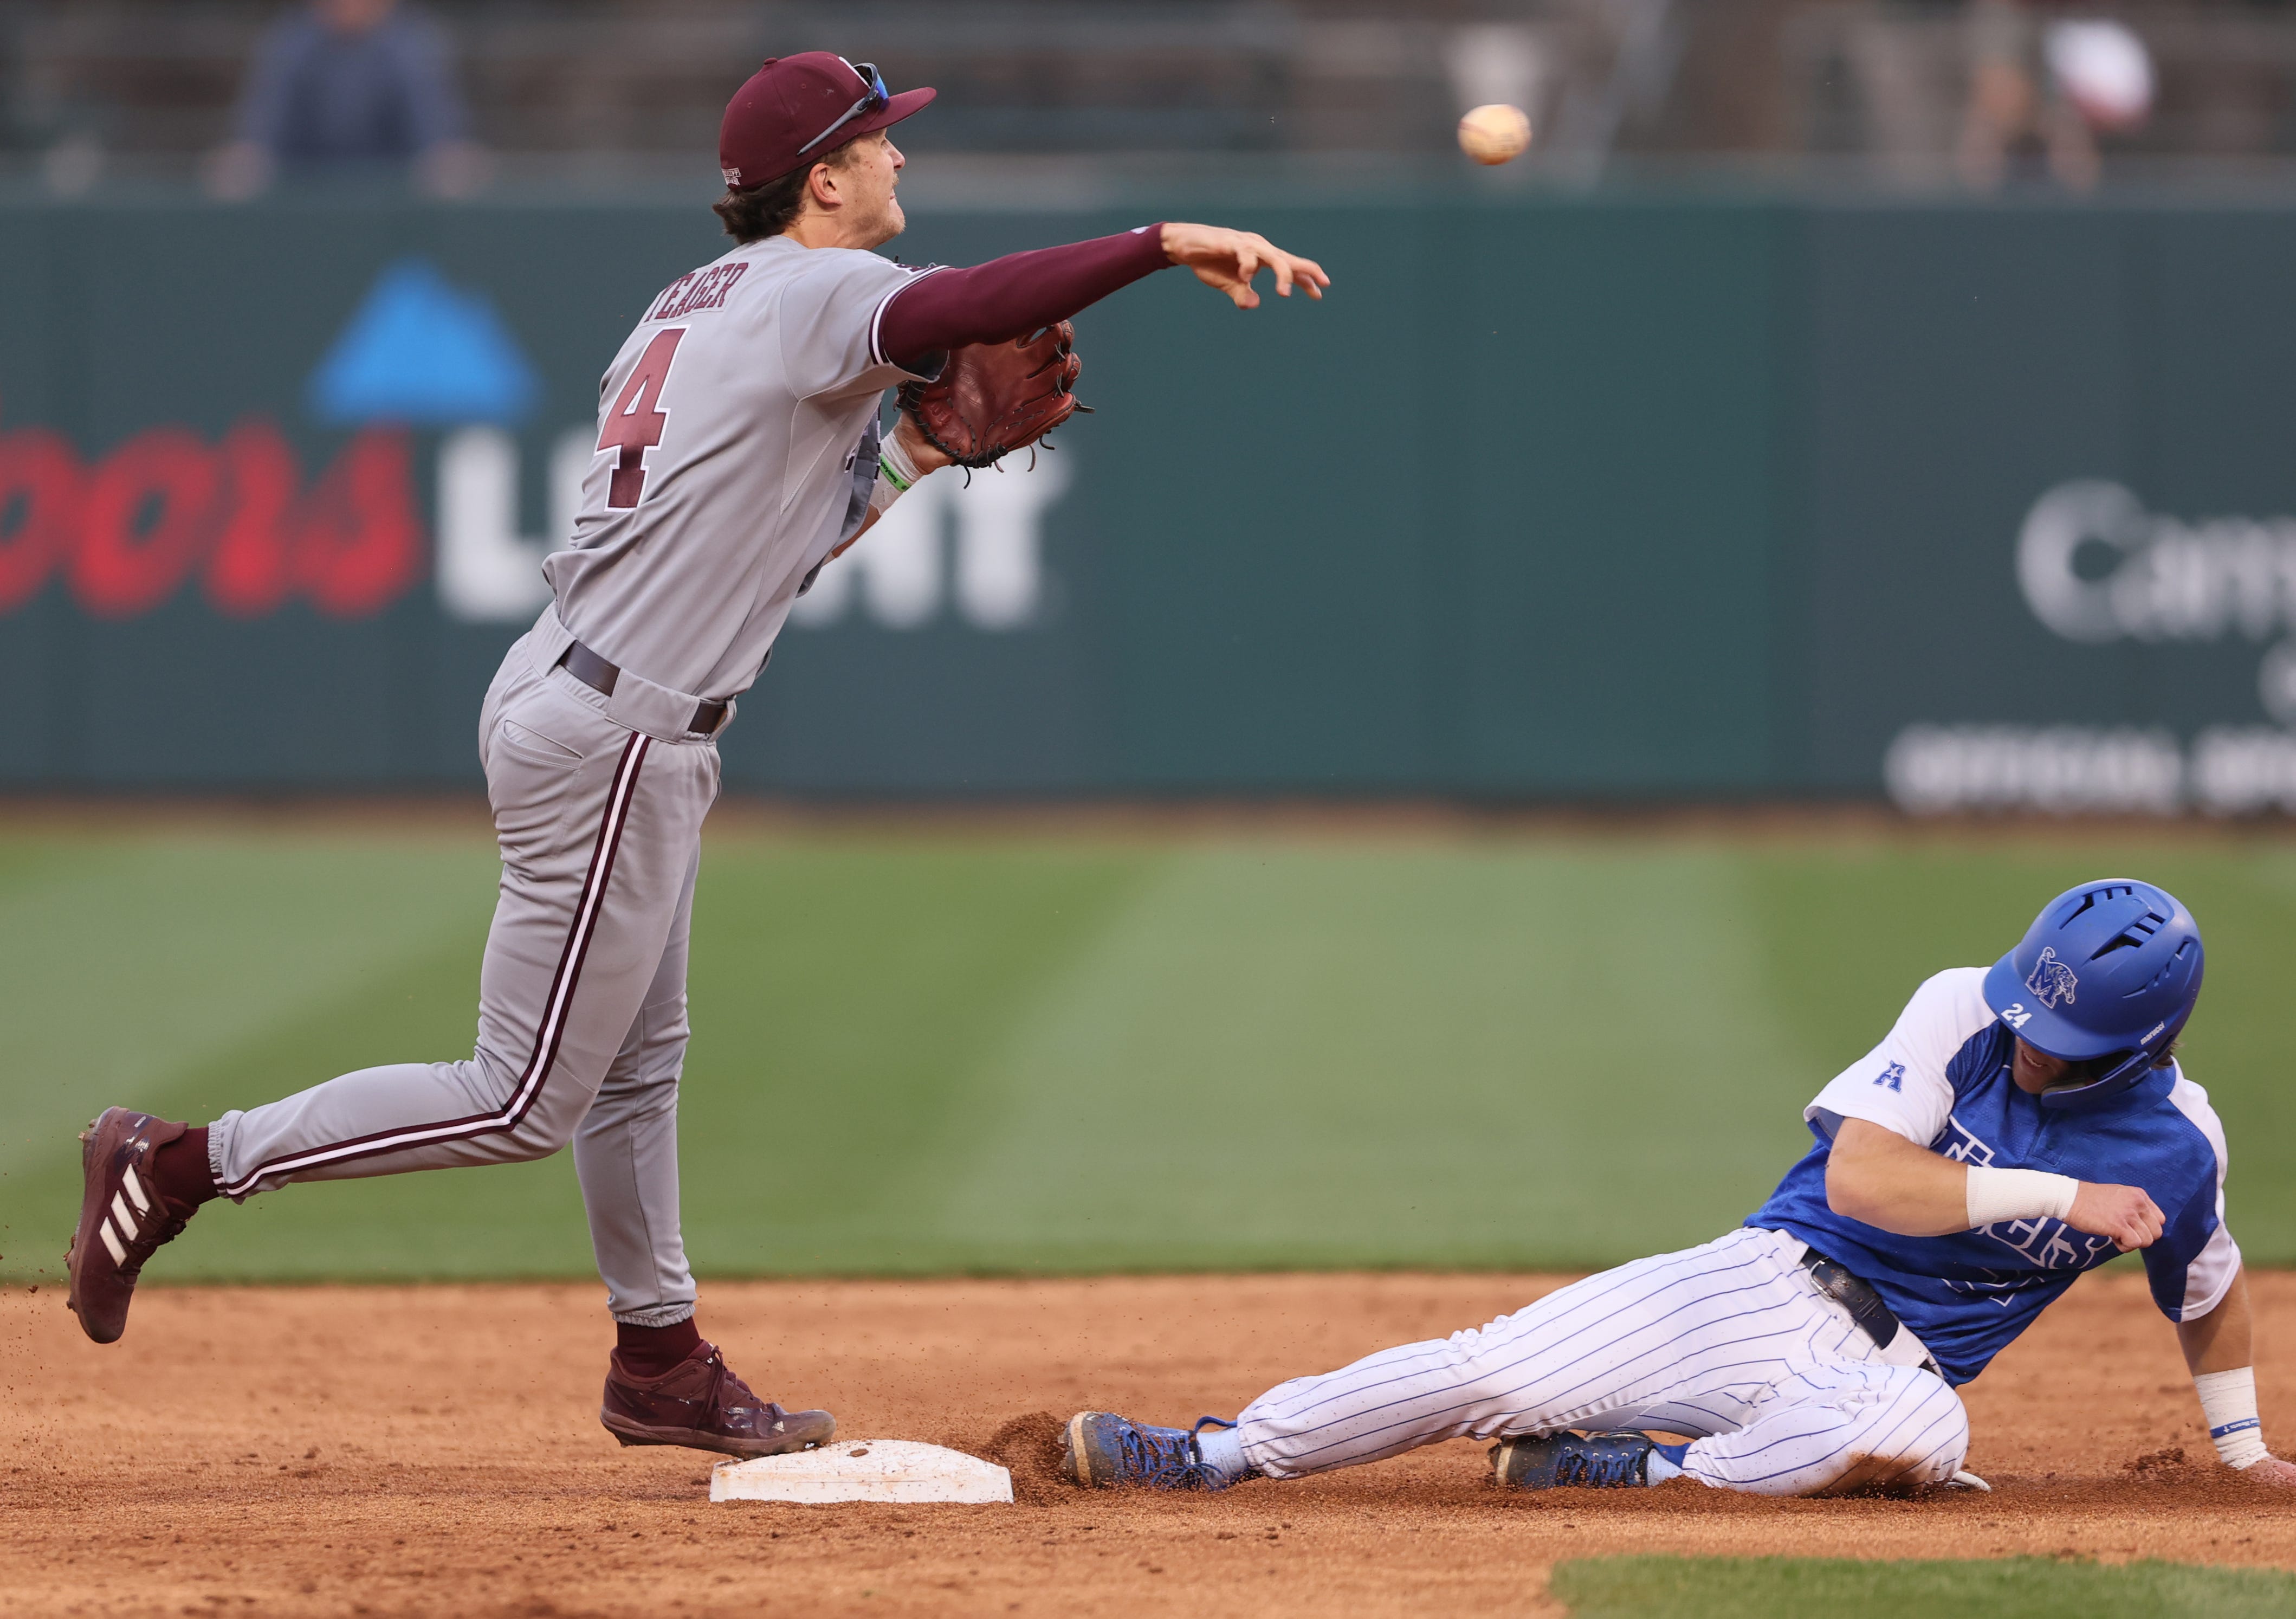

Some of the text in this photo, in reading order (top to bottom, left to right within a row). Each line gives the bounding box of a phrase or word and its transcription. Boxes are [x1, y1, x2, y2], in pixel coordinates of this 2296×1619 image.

[594, 324, 691, 512] 4
[0, 423, 428, 617] oors
[2001, 1003, 2032, 1029] 24
